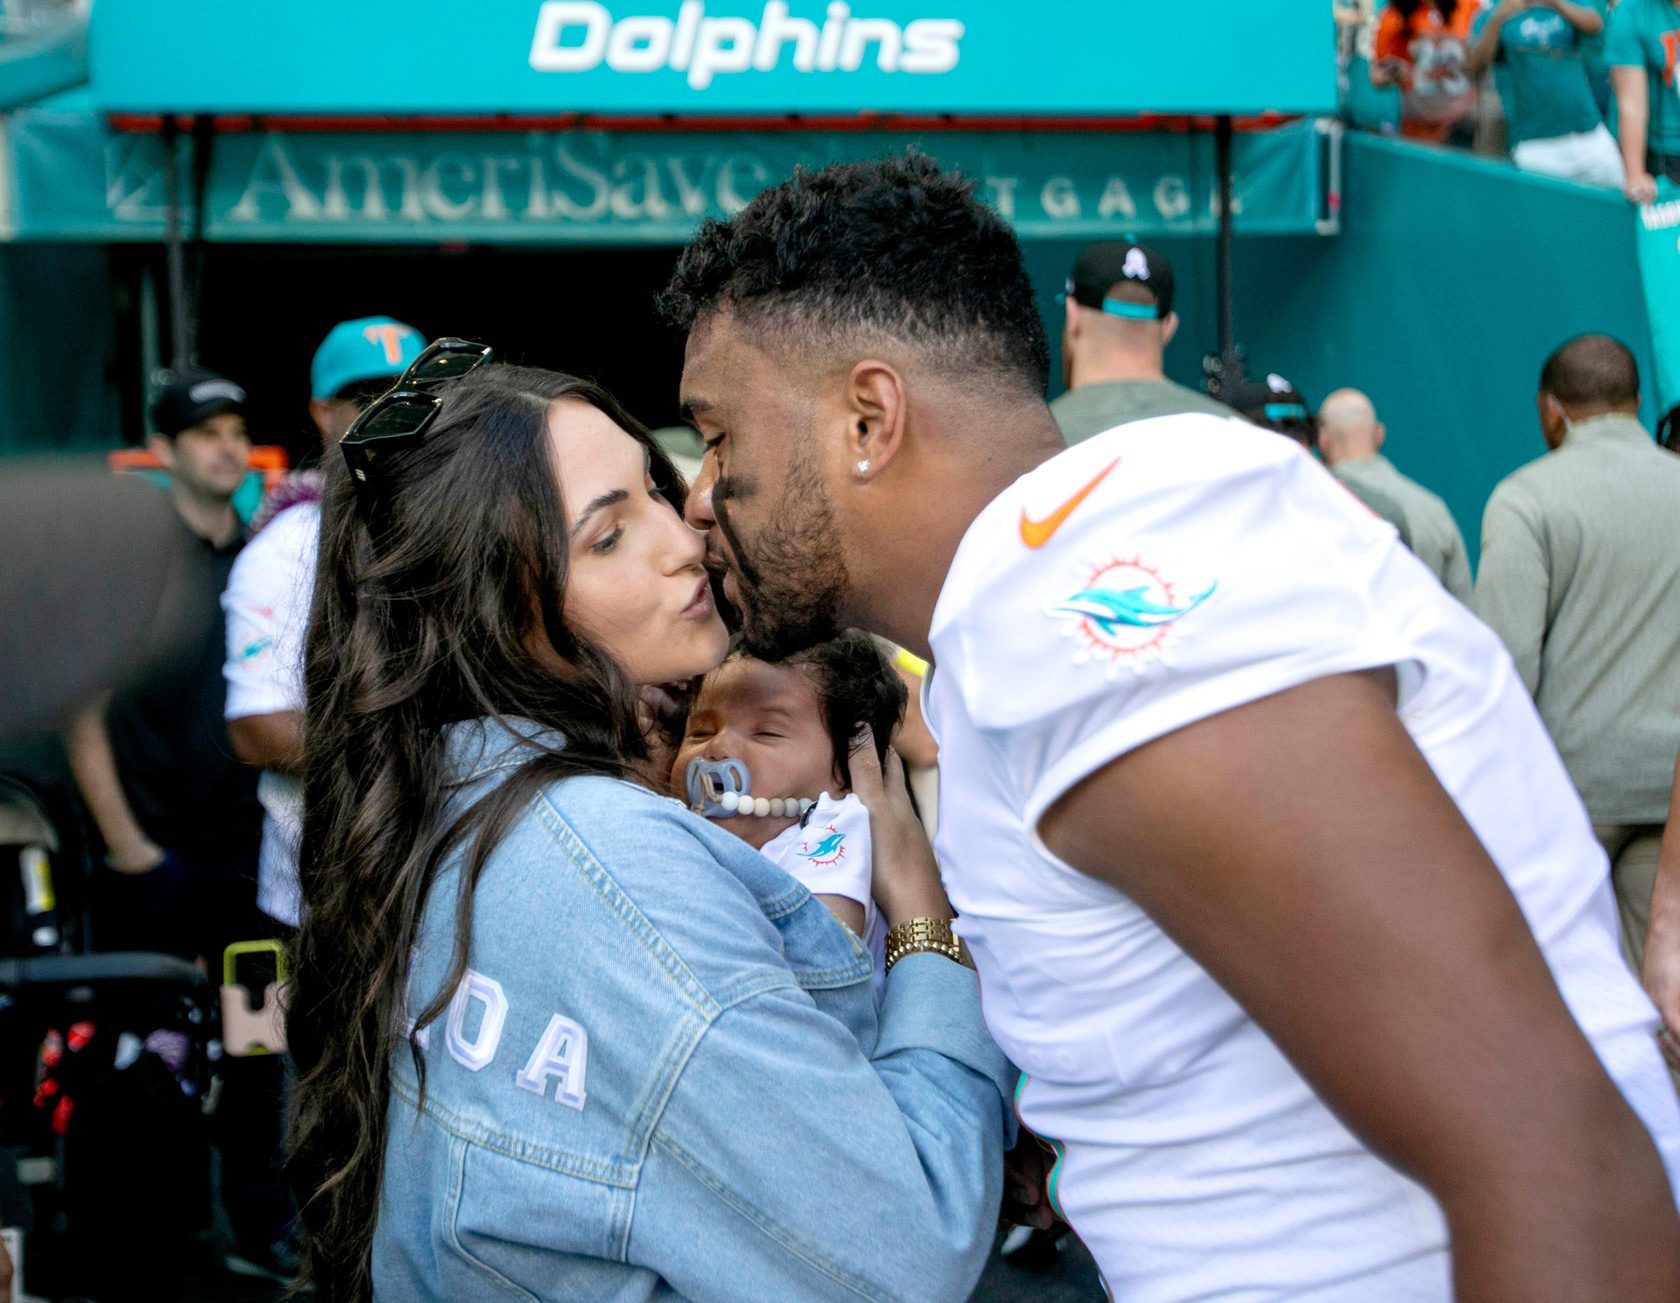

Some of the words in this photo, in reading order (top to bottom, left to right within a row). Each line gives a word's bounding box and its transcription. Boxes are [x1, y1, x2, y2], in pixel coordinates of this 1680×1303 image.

[528, 0, 965, 91] Dolphins
[230, 130, 769, 221] AmeriSave
[403, 943, 588, 1111] OA
